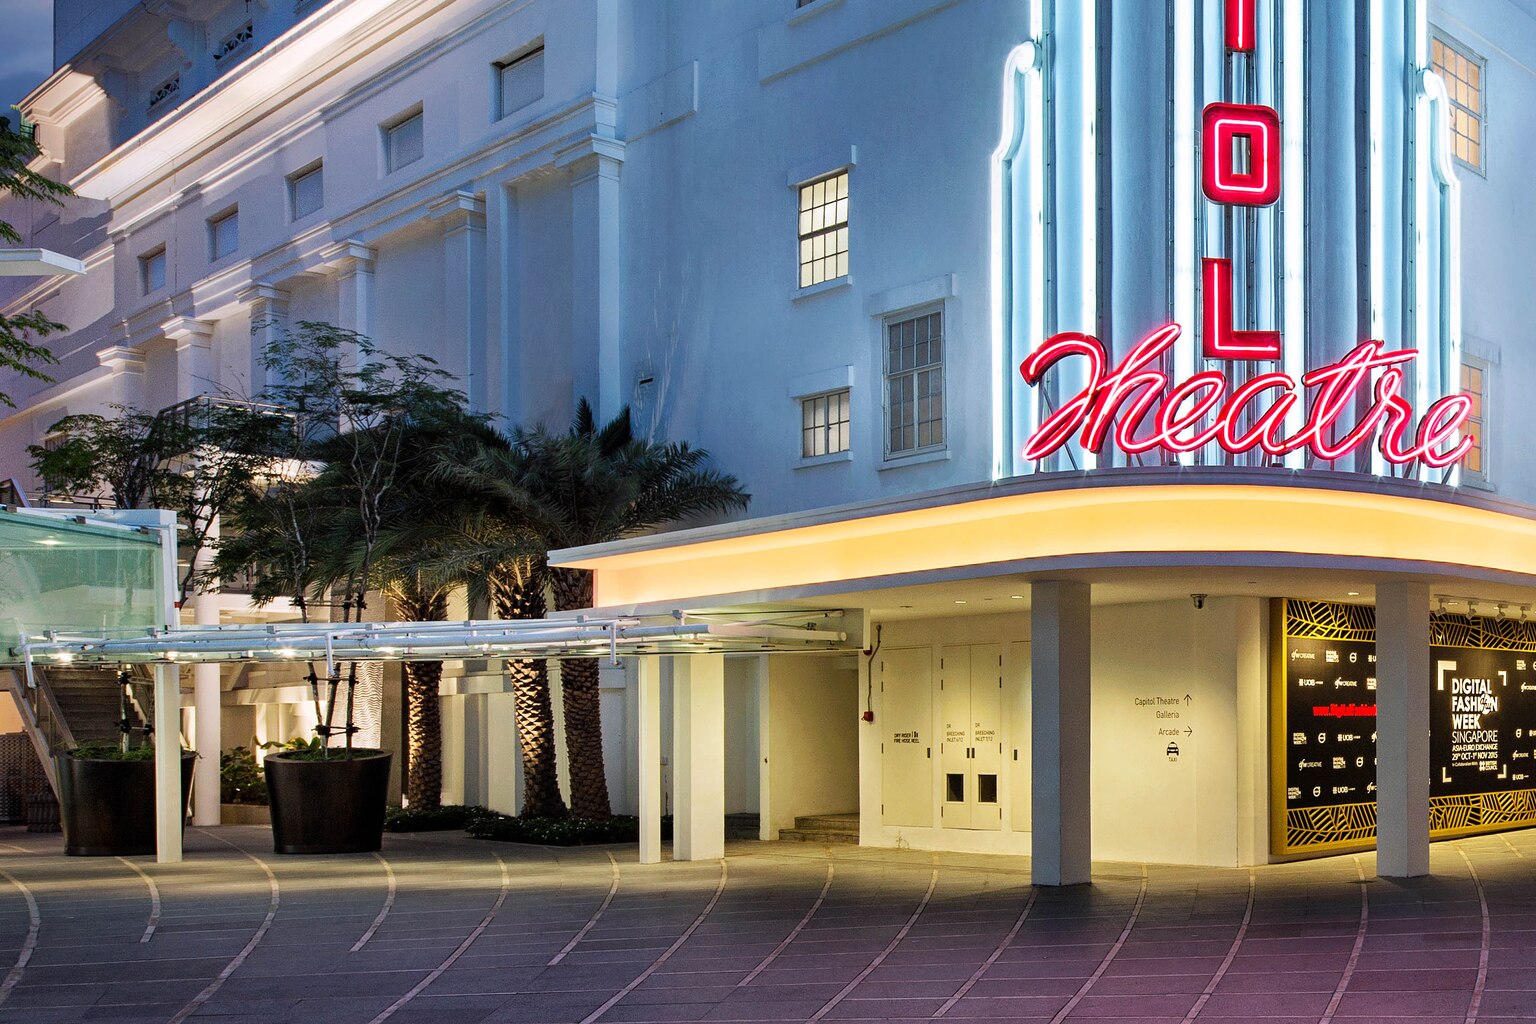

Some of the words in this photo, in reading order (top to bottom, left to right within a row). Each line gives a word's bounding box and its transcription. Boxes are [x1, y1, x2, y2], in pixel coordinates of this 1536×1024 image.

[1020, 323, 1475, 468] Theatre
[1452, 678, 1492, 694] DIGITAL
[1135, 697, 1155, 706] Capitol
[1156, 696, 1179, 705] Theatre
[1156, 710, 1179, 718] Galleria
[1452, 714, 1481, 729] WEEK
[1452, 730, 1498, 743] SINGAPORE
[1452, 744, 1475, 752] ASIA-EURO
